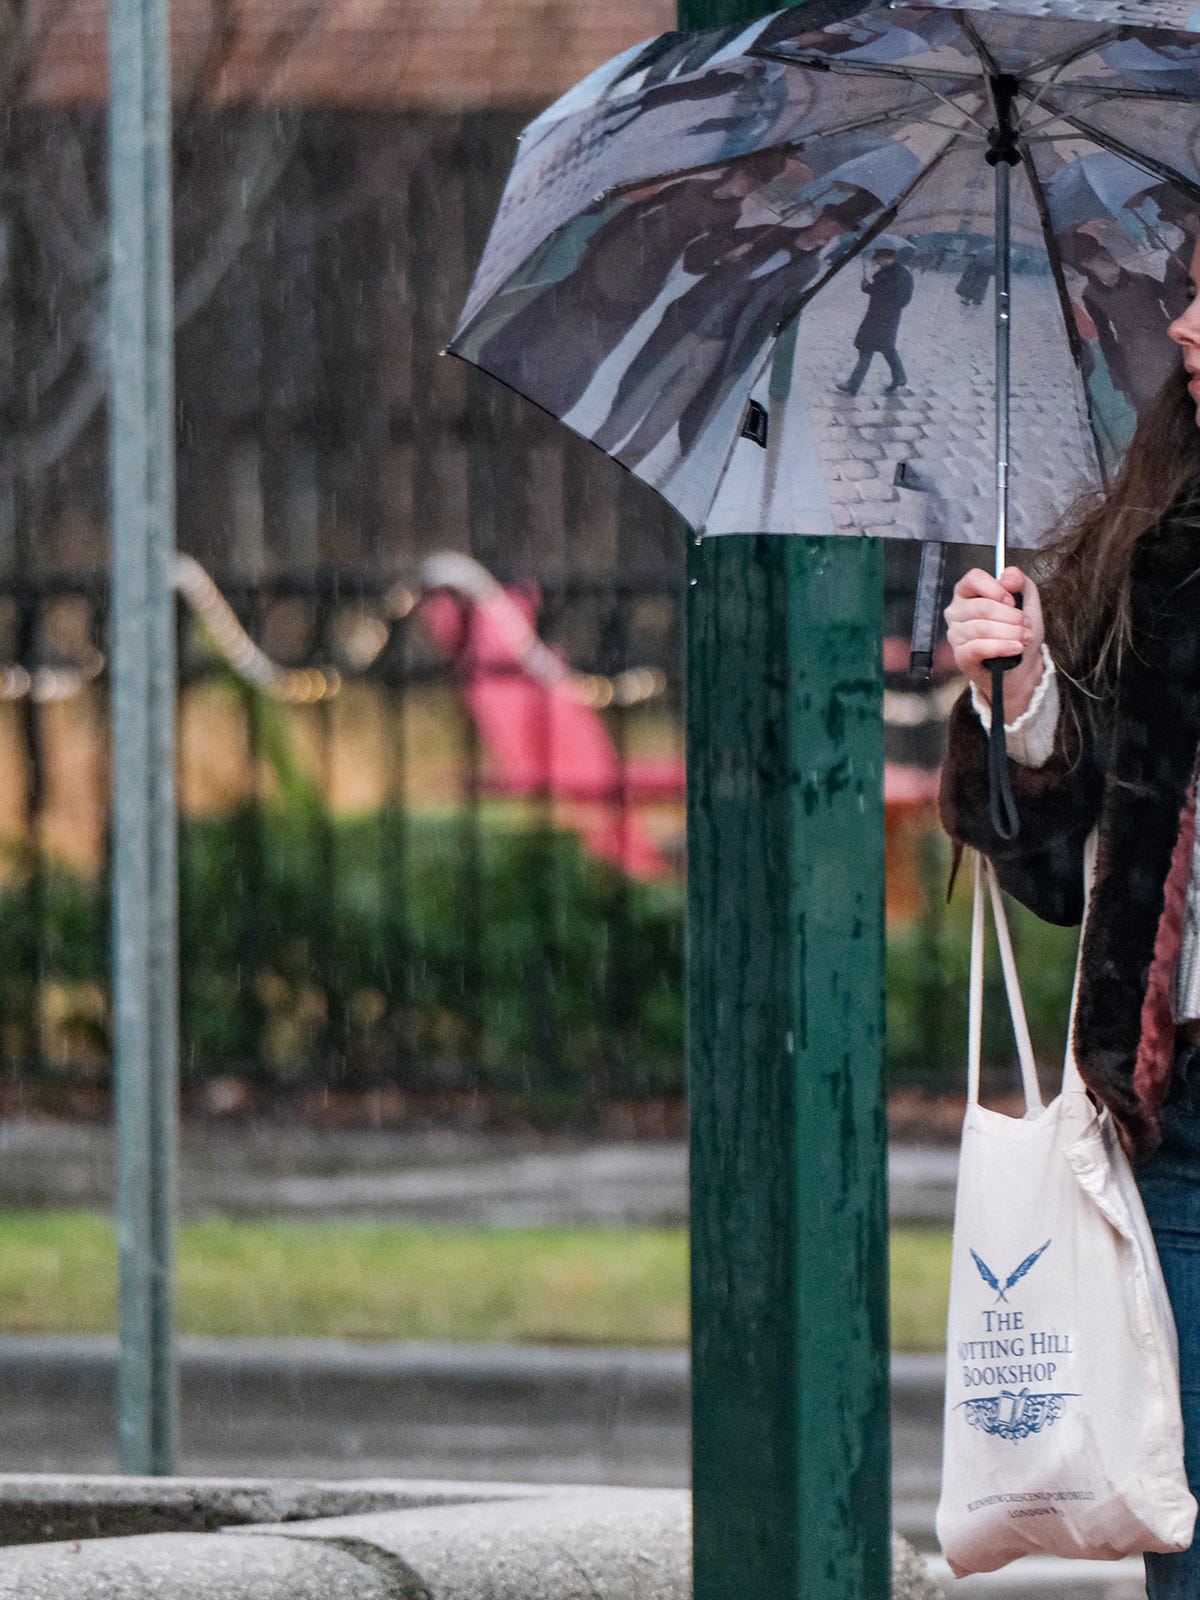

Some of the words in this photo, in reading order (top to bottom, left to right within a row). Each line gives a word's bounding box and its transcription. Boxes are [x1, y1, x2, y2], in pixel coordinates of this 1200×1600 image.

[982, 1310, 1025, 1333] THE
[958, 1338, 1025, 1360] OTTING
[1029, 1332, 1073, 1355] HILL
